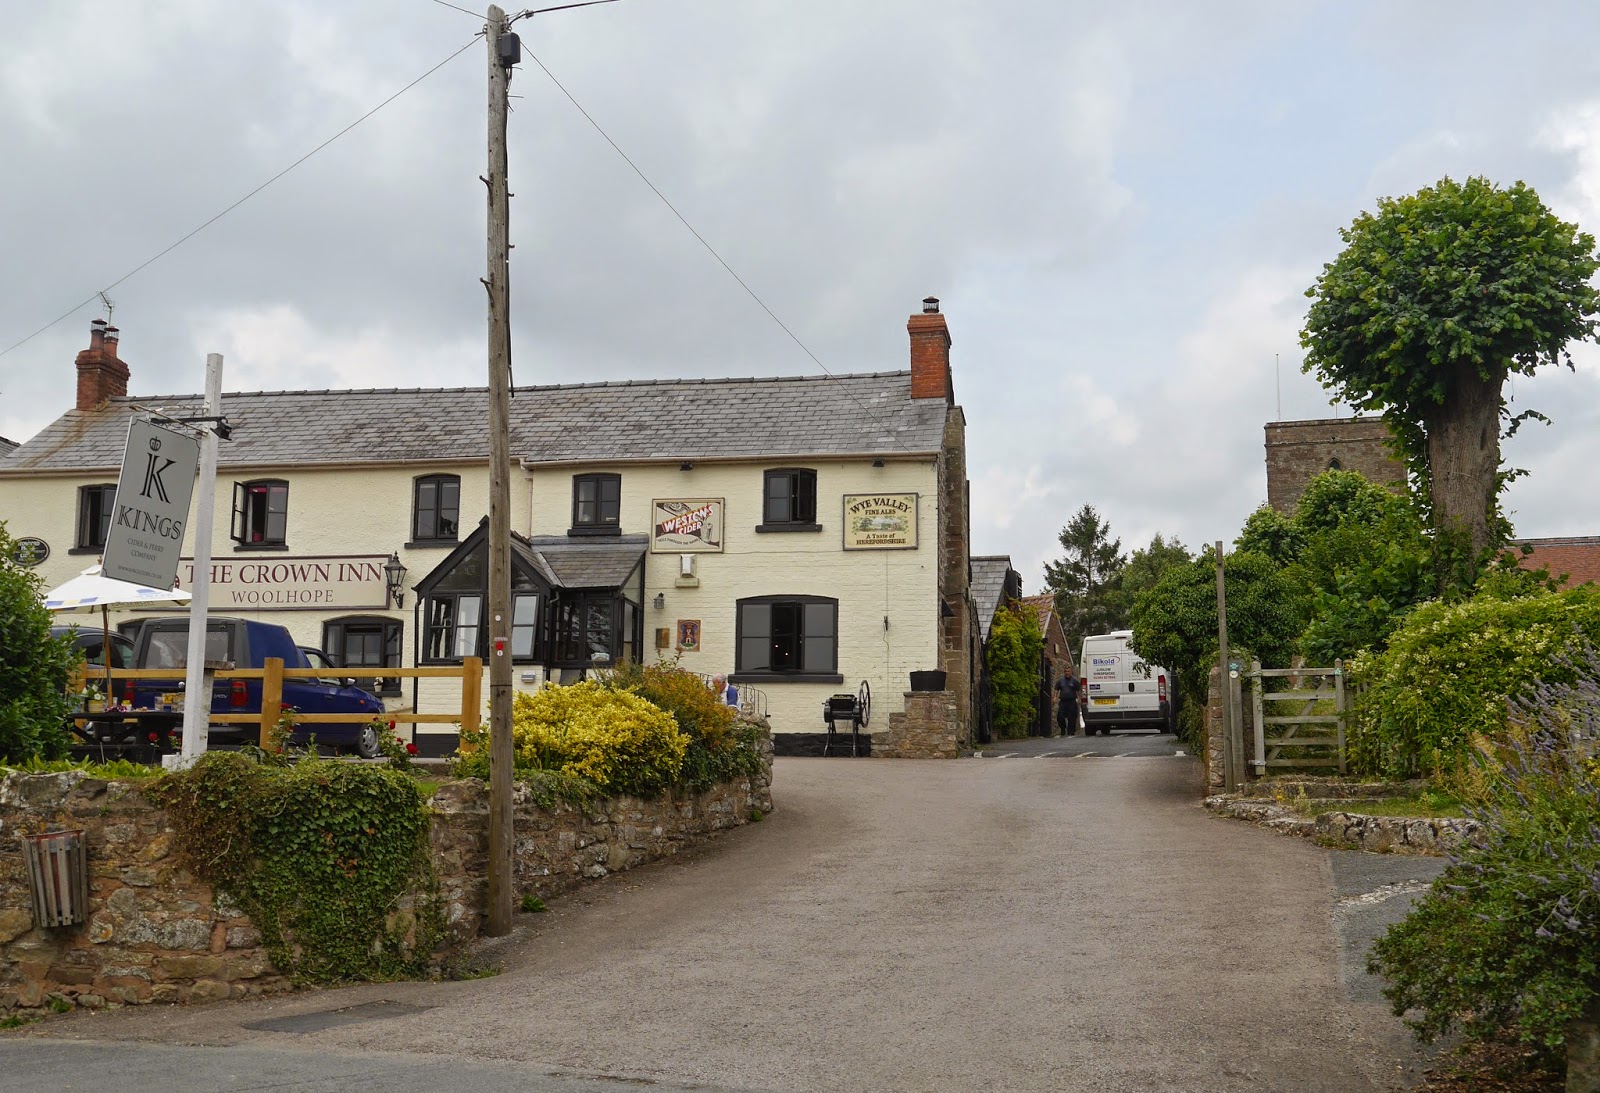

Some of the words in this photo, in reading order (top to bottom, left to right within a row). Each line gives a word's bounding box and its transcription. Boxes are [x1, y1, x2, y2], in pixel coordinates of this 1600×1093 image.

[850, 499, 872, 514] WYE
[873, 498, 911, 513] VALLEY
[117, 505, 182, 540] KINGS
[662, 505, 714, 532] WESTON'S
[678, 521, 702, 536] CIDER
[127, 537, 144, 548] CIDER
[131, 549, 156, 561] COMPANY
[239, 563, 331, 584] CROWN
[337, 562, 384, 583] INN
[231, 589, 334, 604] WOOLHOPE
